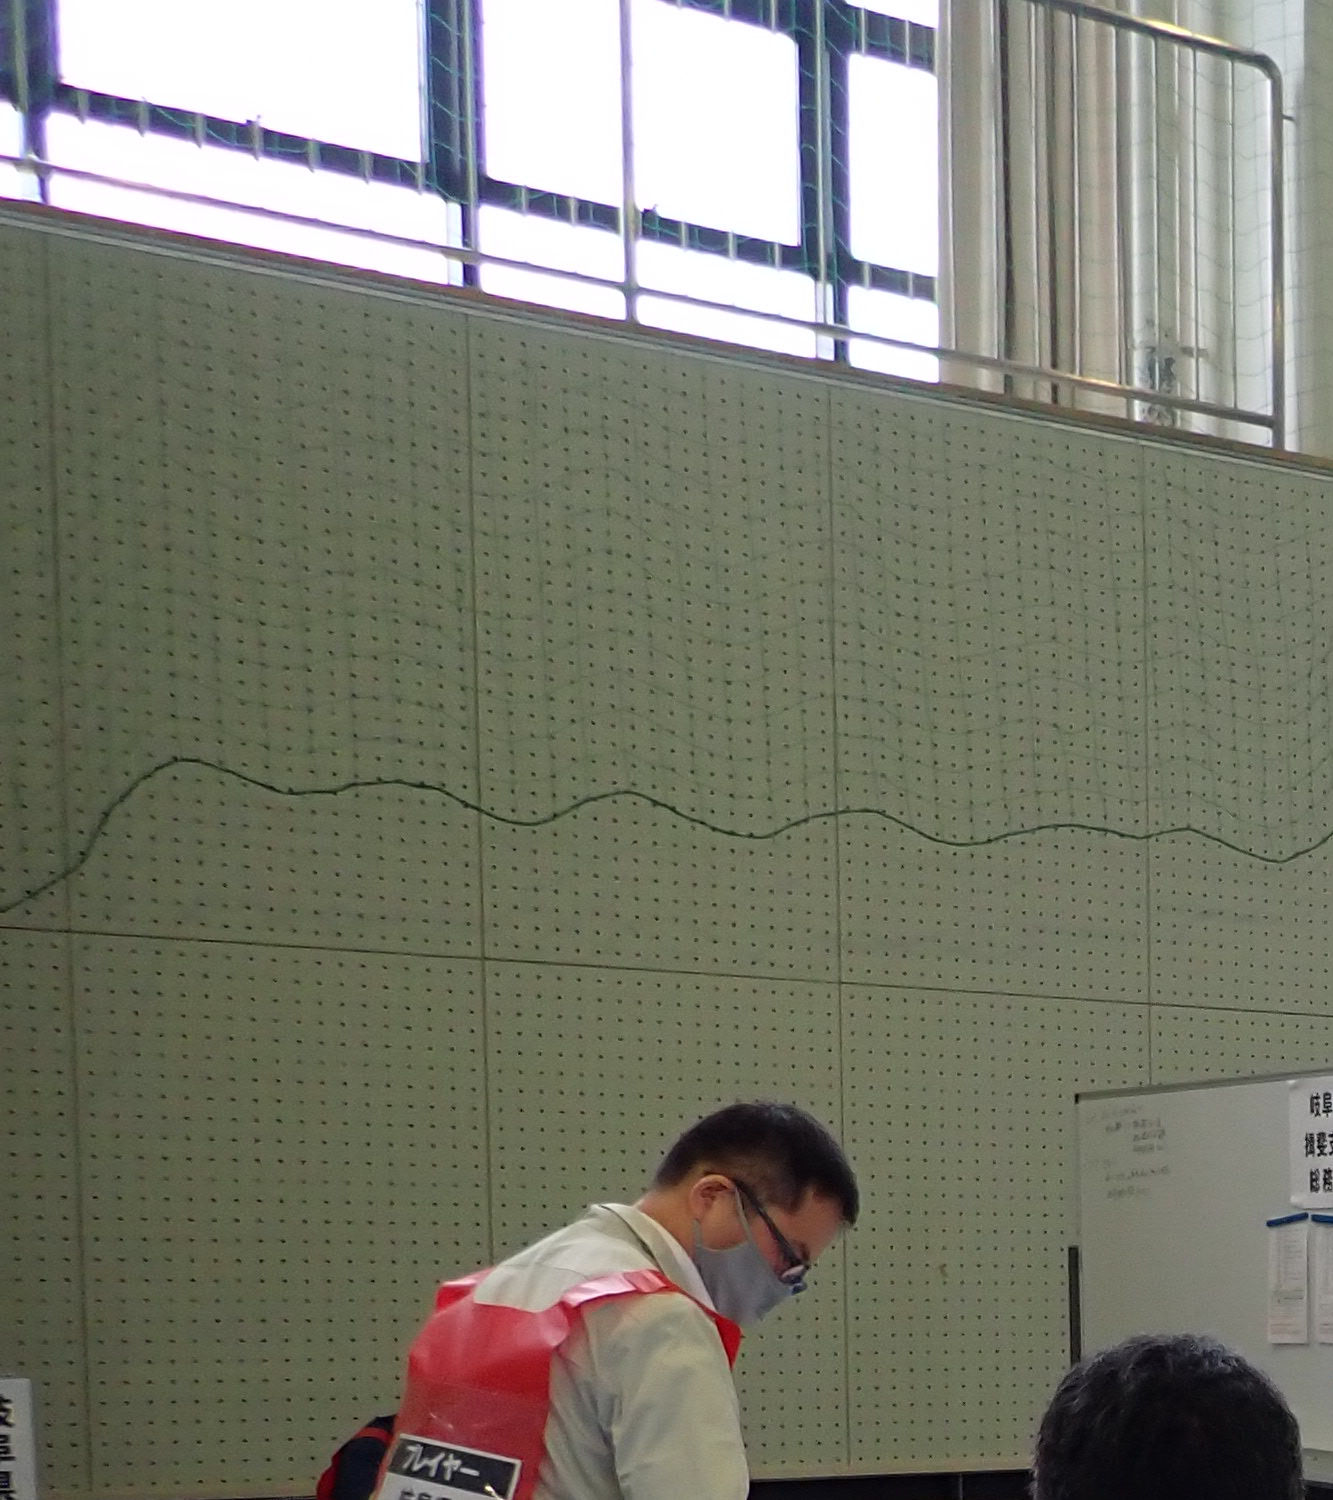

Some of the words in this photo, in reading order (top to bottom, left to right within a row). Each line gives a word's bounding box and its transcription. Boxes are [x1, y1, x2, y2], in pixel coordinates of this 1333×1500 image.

[402, 1443, 481, 1481] プレイヤー
